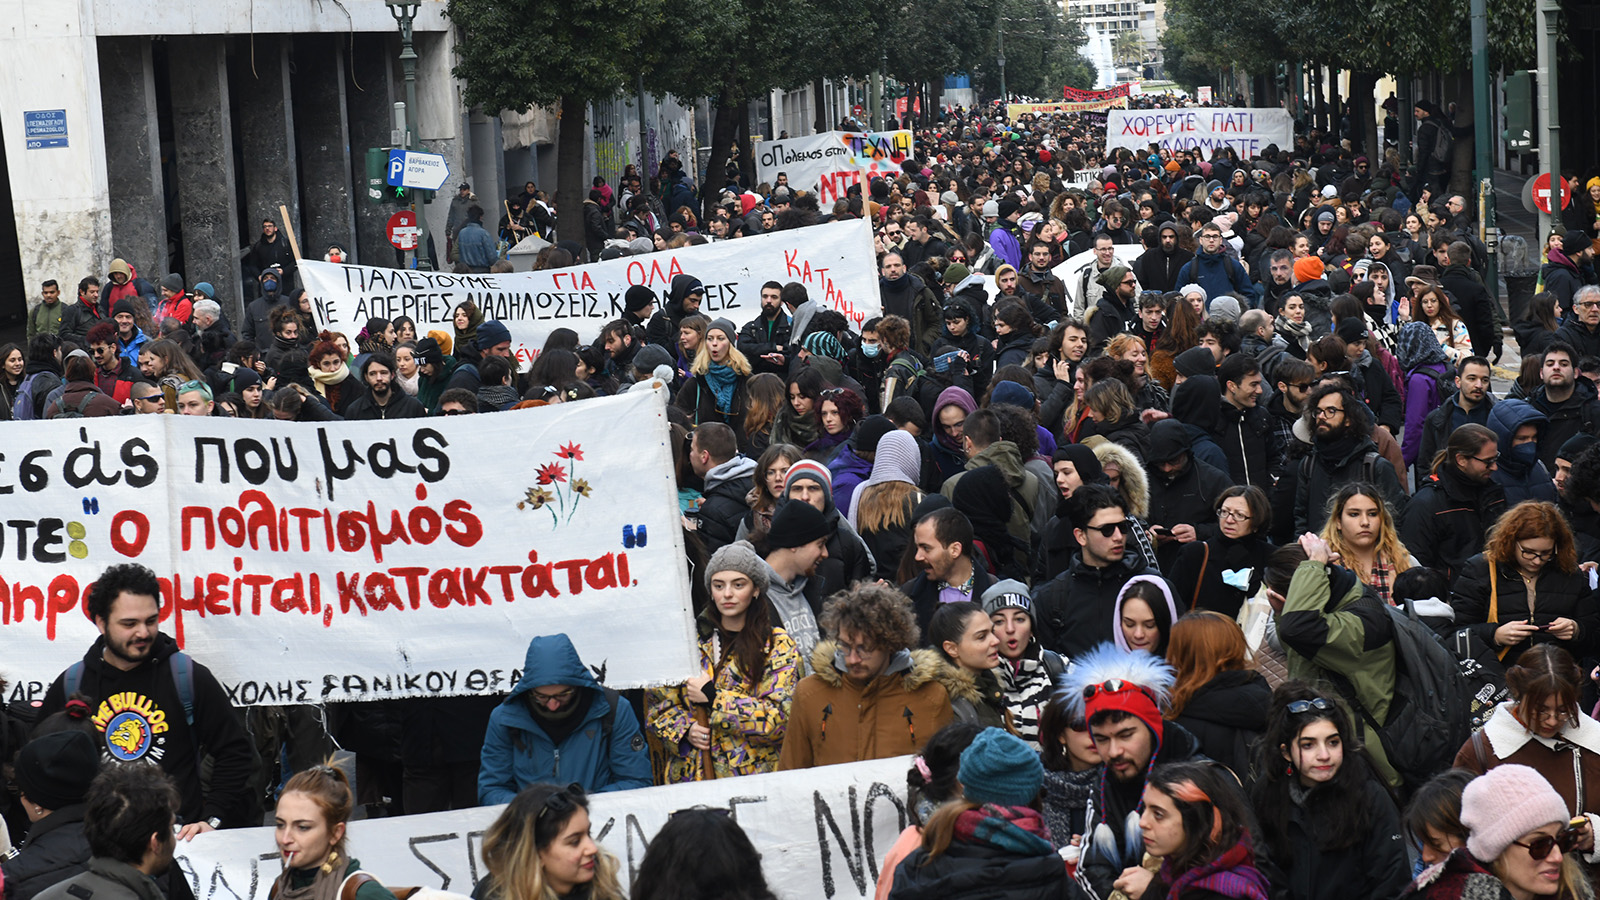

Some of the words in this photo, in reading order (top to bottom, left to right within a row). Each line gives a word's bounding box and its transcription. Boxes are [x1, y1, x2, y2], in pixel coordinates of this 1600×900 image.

[1031, 104, 1071, 112] ΚΑΝΕΑΣ
[1121, 113, 1196, 136] ΧΟΡΕΨΤΕ
[341, 266, 501, 293] ΠΑΛΕΥΟΥΜΕ
[552, 271, 596, 291] ΓΙΑ
[626, 256, 685, 287] ΟΛΑ
[194, 436, 299, 485] που
[316, 427, 450, 501] μας
[181, 483, 483, 563] πολιτισμός
[222, 679, 312, 706] ΧΟΛΗΣ
